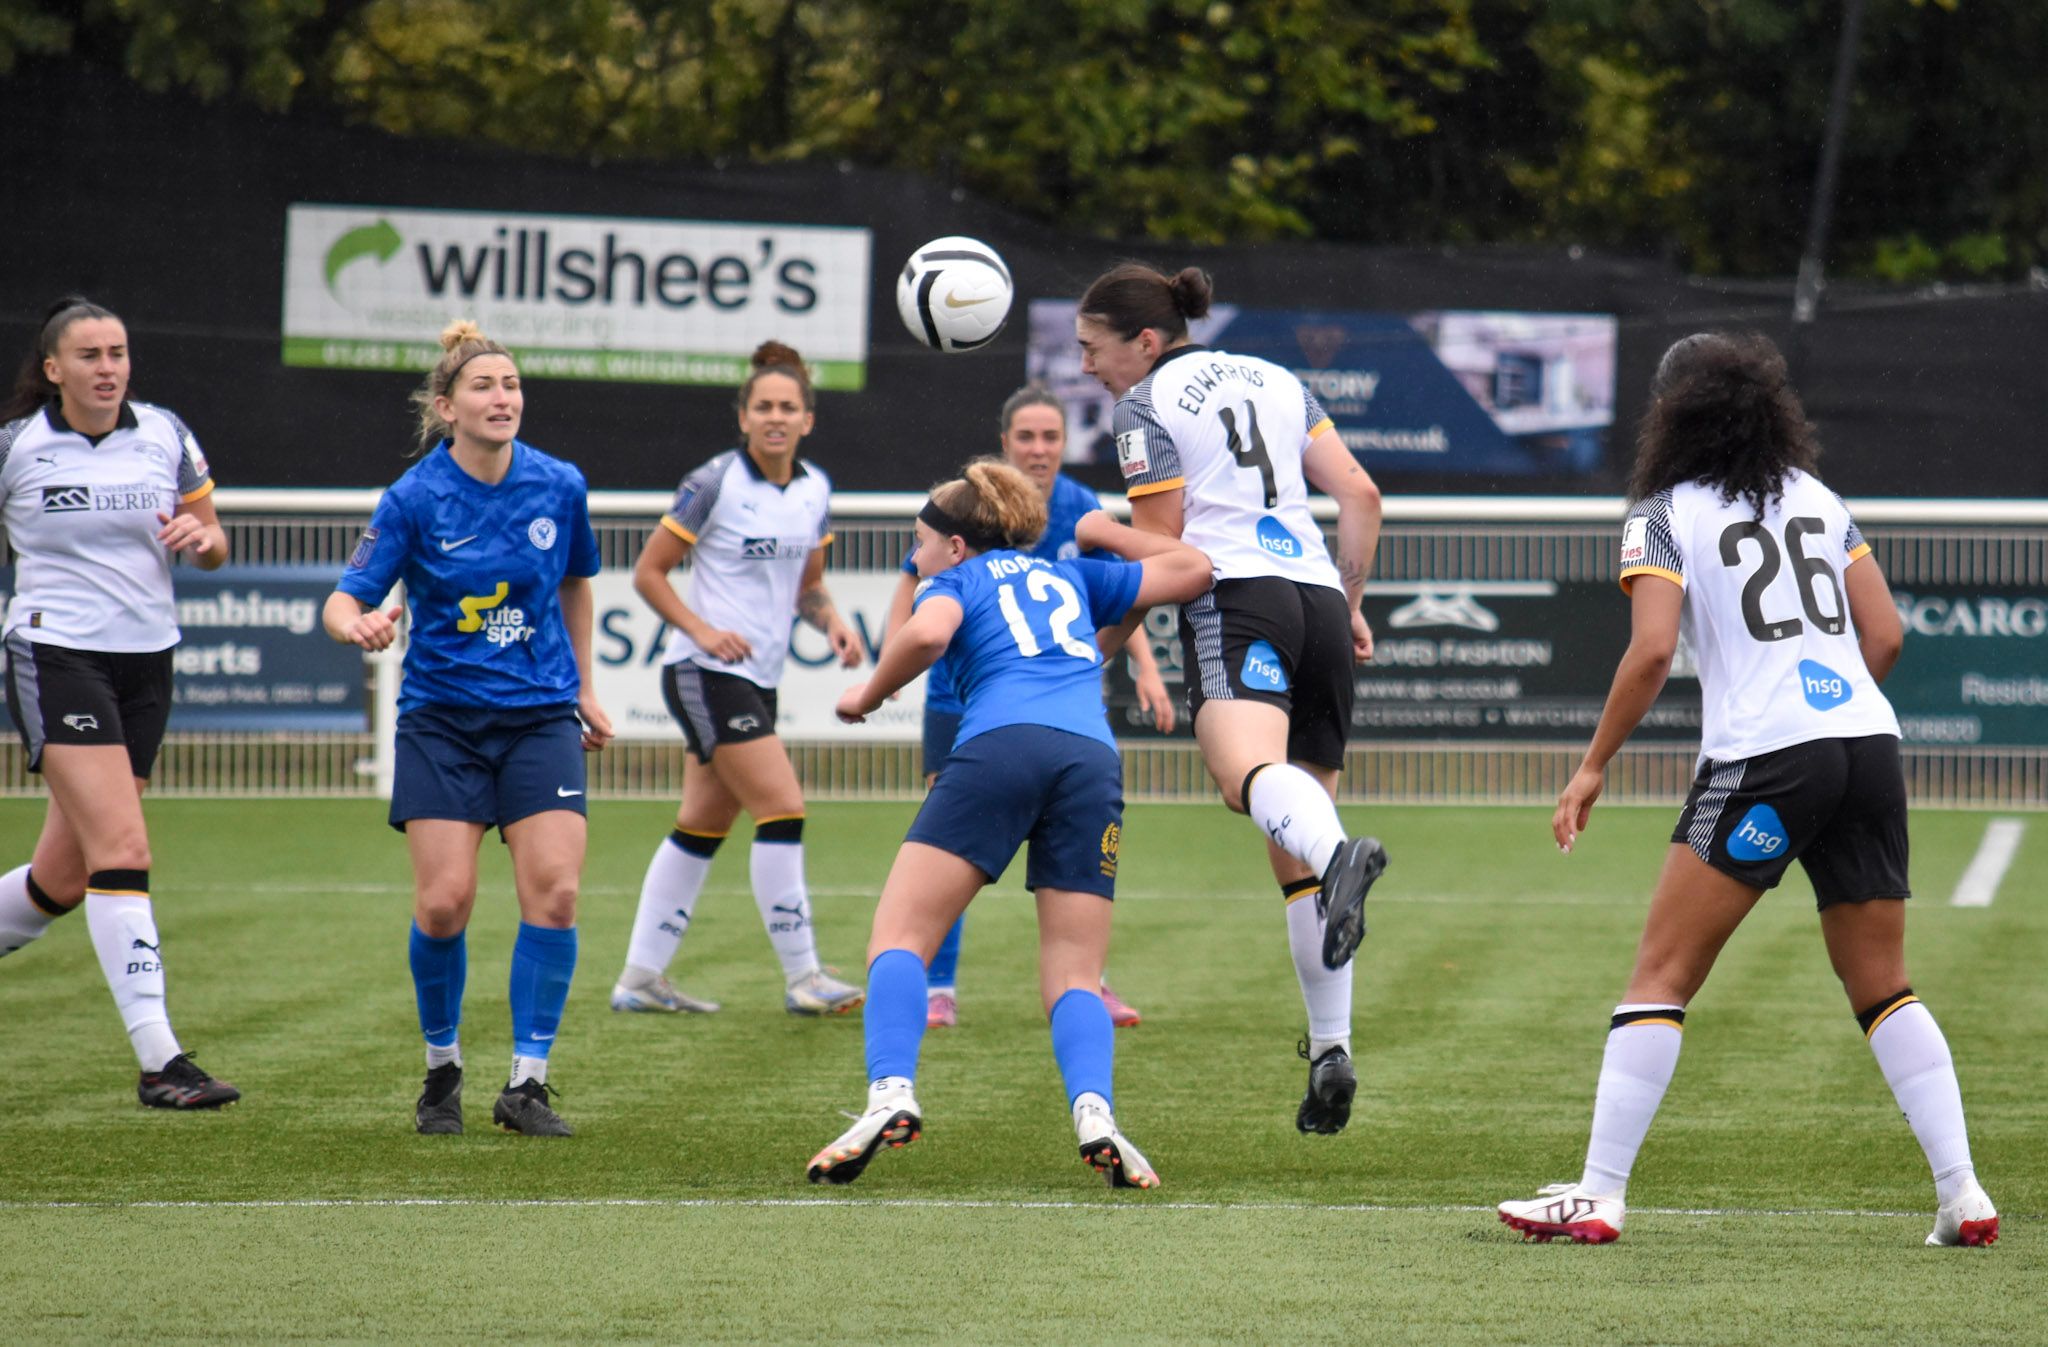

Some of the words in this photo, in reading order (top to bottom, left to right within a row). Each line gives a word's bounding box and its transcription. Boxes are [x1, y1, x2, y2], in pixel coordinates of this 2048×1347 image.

[418, 226, 818, 314] willshee's
[1178, 363, 1265, 416] EDWARDS
[1218, 399, 1278, 510] 4
[96, 492, 161, 510] DERBY
[1261, 535, 1294, 555] hsg
[1719, 517, 1846, 642] 26
[998, 570, 1096, 664] 12
[1248, 656, 1281, 685] hsg
[1805, 676, 1843, 698] hsg
[1738, 820, 1783, 853] hsg
